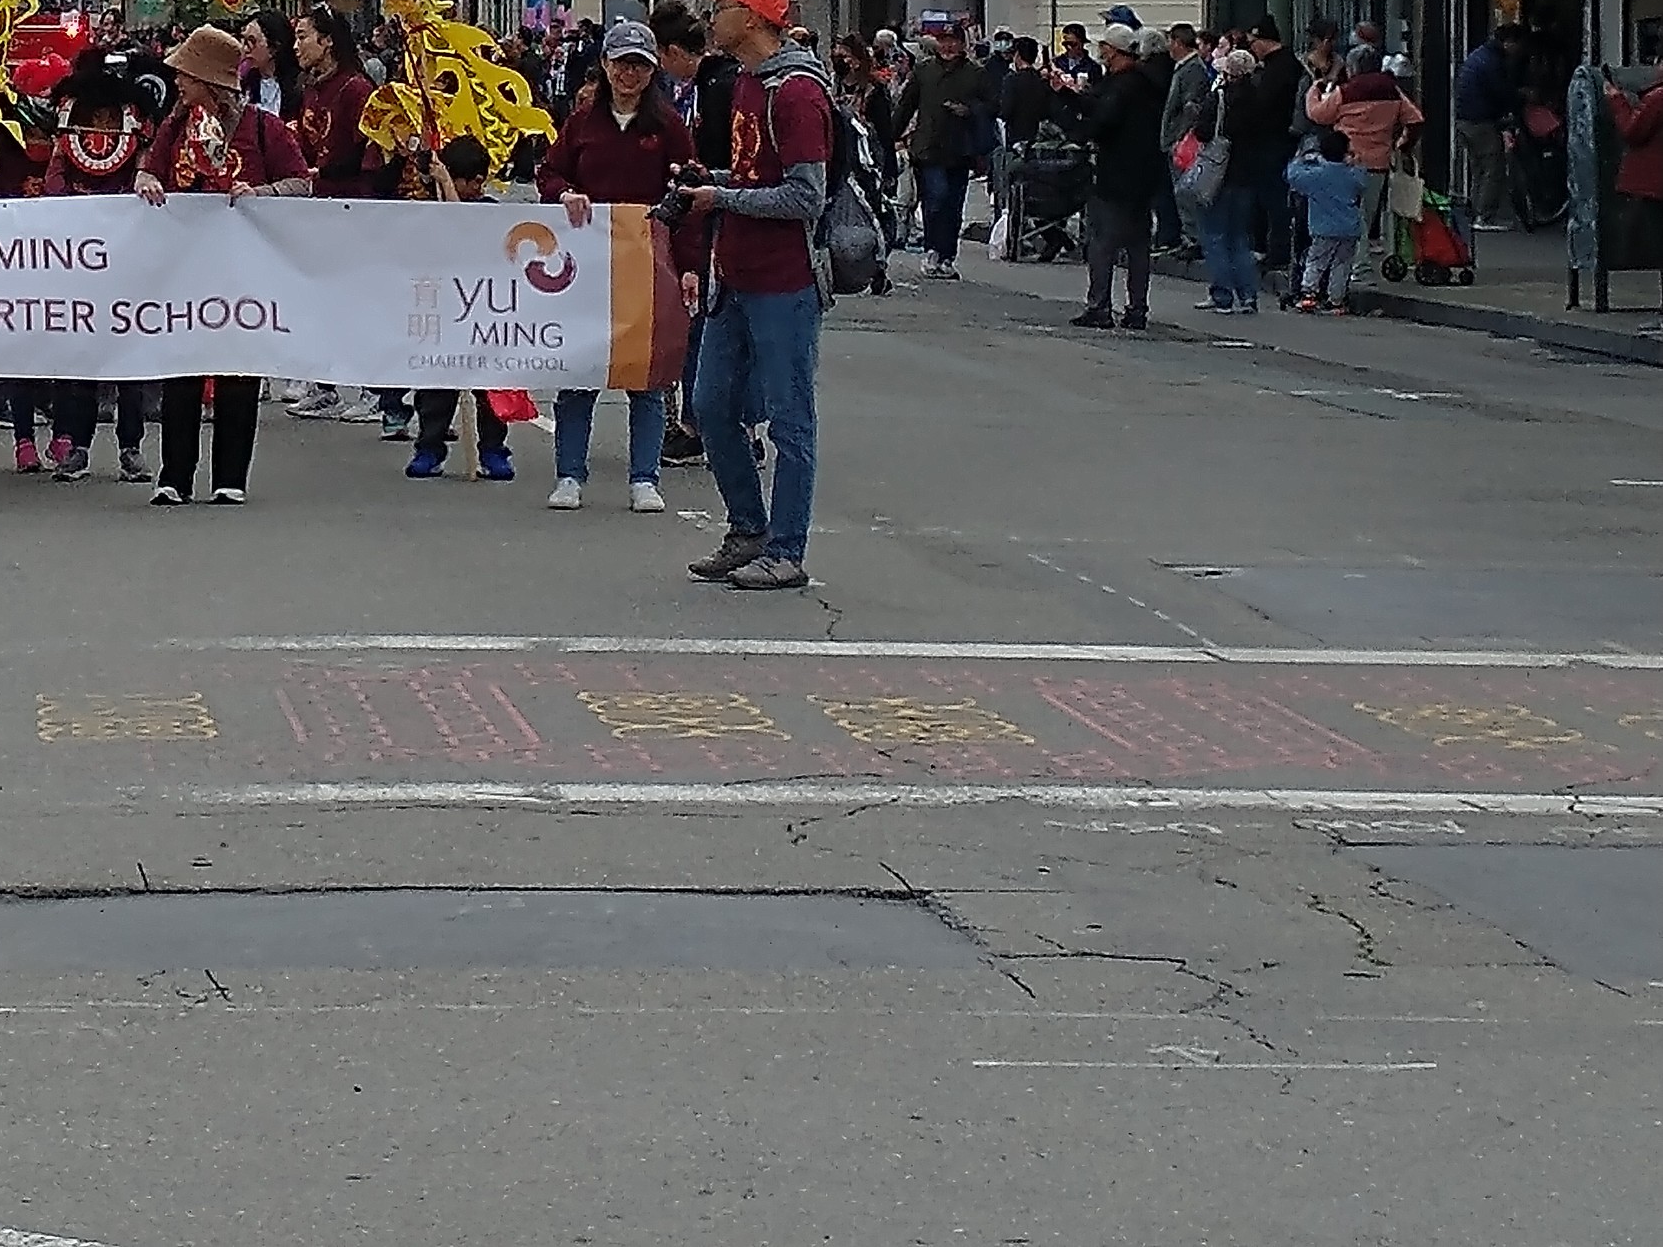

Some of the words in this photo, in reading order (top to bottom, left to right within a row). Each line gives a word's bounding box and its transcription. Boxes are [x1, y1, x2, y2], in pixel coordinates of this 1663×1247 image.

[110, 296, 290, 335] SCHOOL
[470, 321, 563, 349] MING
[408, 354, 488, 370] CHARTER
[494, 356, 569, 371] SCHOOL
